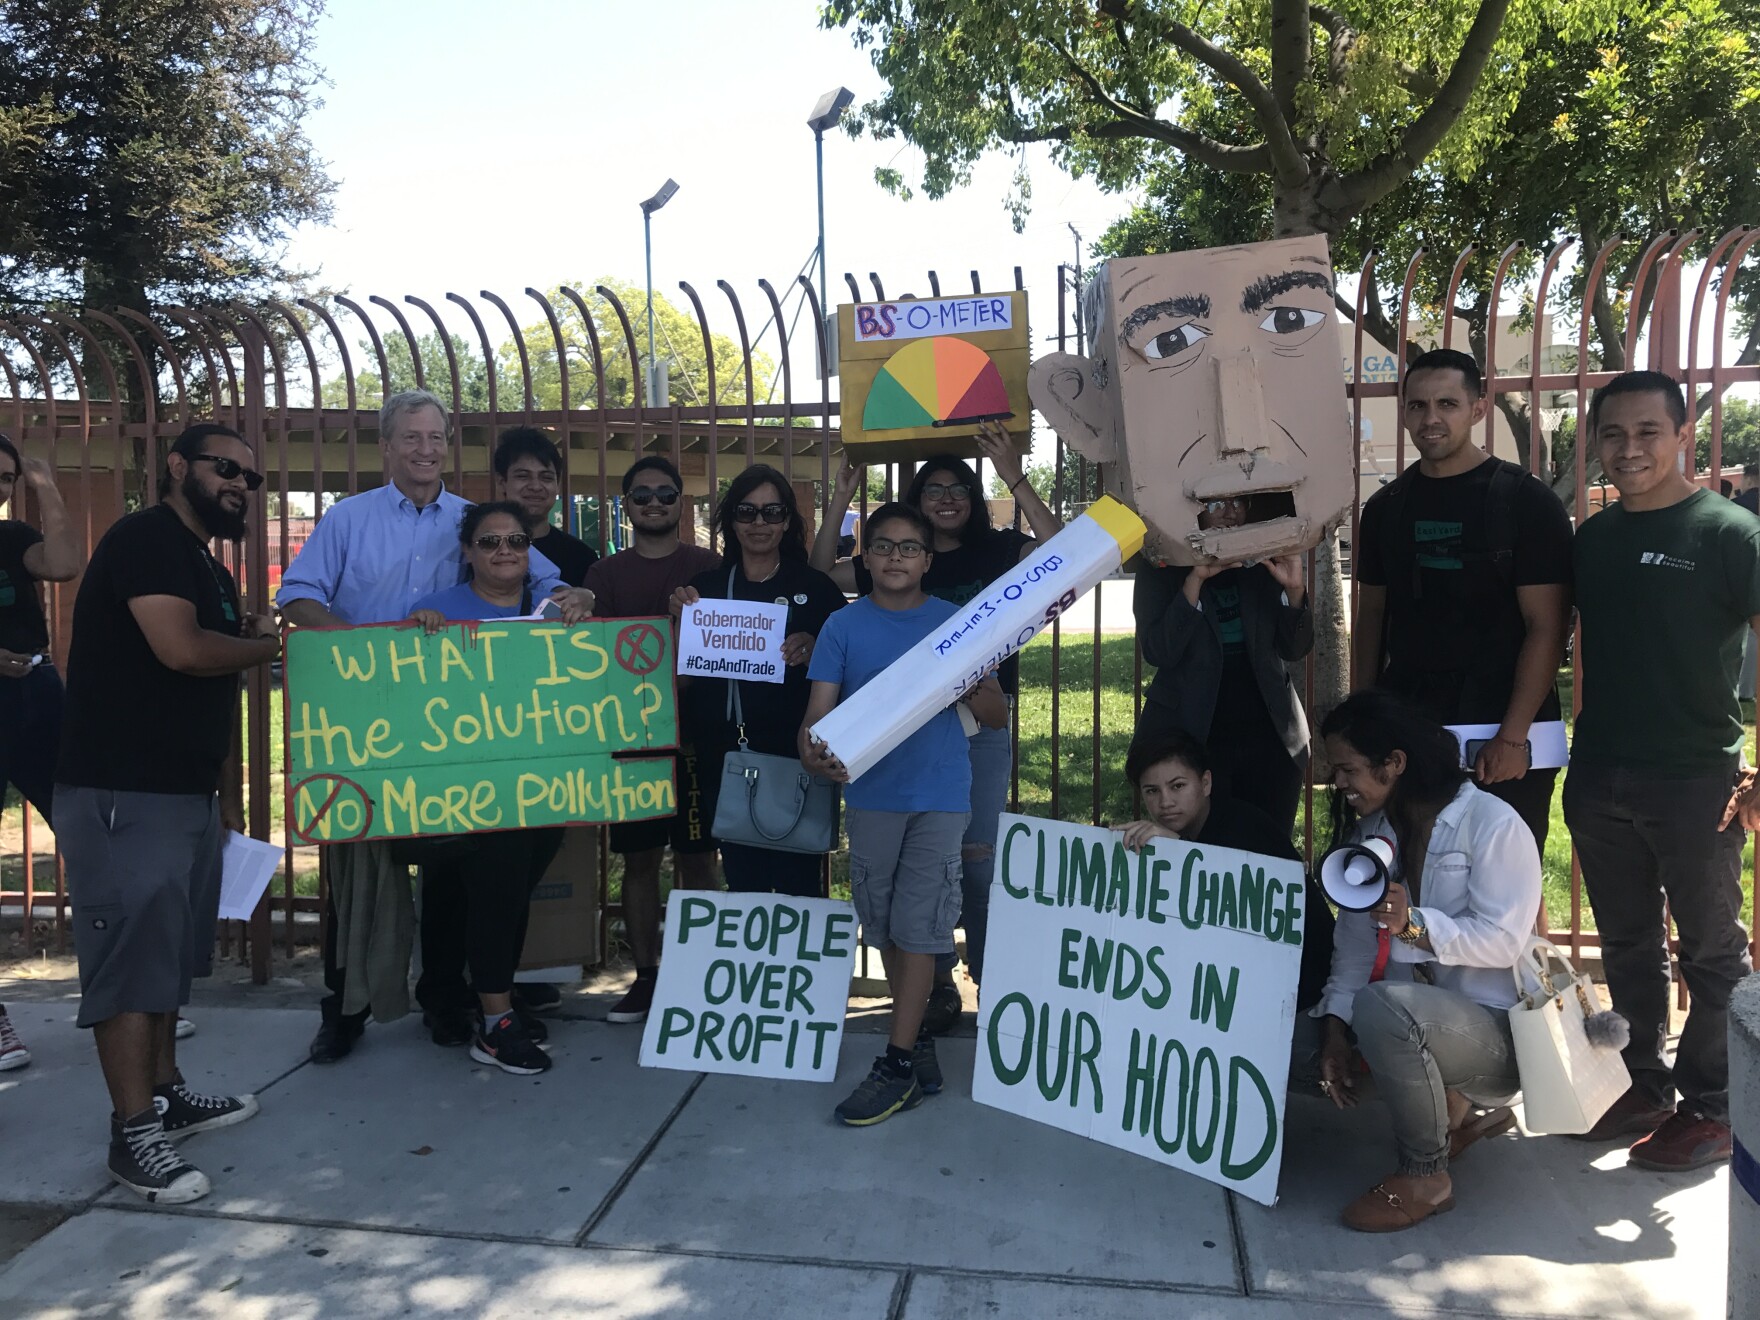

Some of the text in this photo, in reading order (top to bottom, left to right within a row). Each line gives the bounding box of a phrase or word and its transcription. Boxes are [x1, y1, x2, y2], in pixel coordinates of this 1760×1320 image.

[857, 299, 1008, 339] BS-O-METER
[693, 609, 776, 631] Gobernador
[701, 629, 766, 652] Vendido
[331, 628, 609, 685] WHAT IS
[686, 655, 776, 676] #CapAndTrade
[290, 682, 663, 769] the Solution?
[298, 778, 362, 839] No
[685, 756, 702, 841] FITCH
[1001, 822, 1303, 945] CLIMATE CHANGE
[677, 897, 853, 962] PEOPLE
[704, 959, 815, 1015] OVER
[1059, 928, 1240, 1033] ENDS IN
[656, 1007, 838, 1070] PROFIT
[987, 992, 1278, 1181] OUR HOOD
